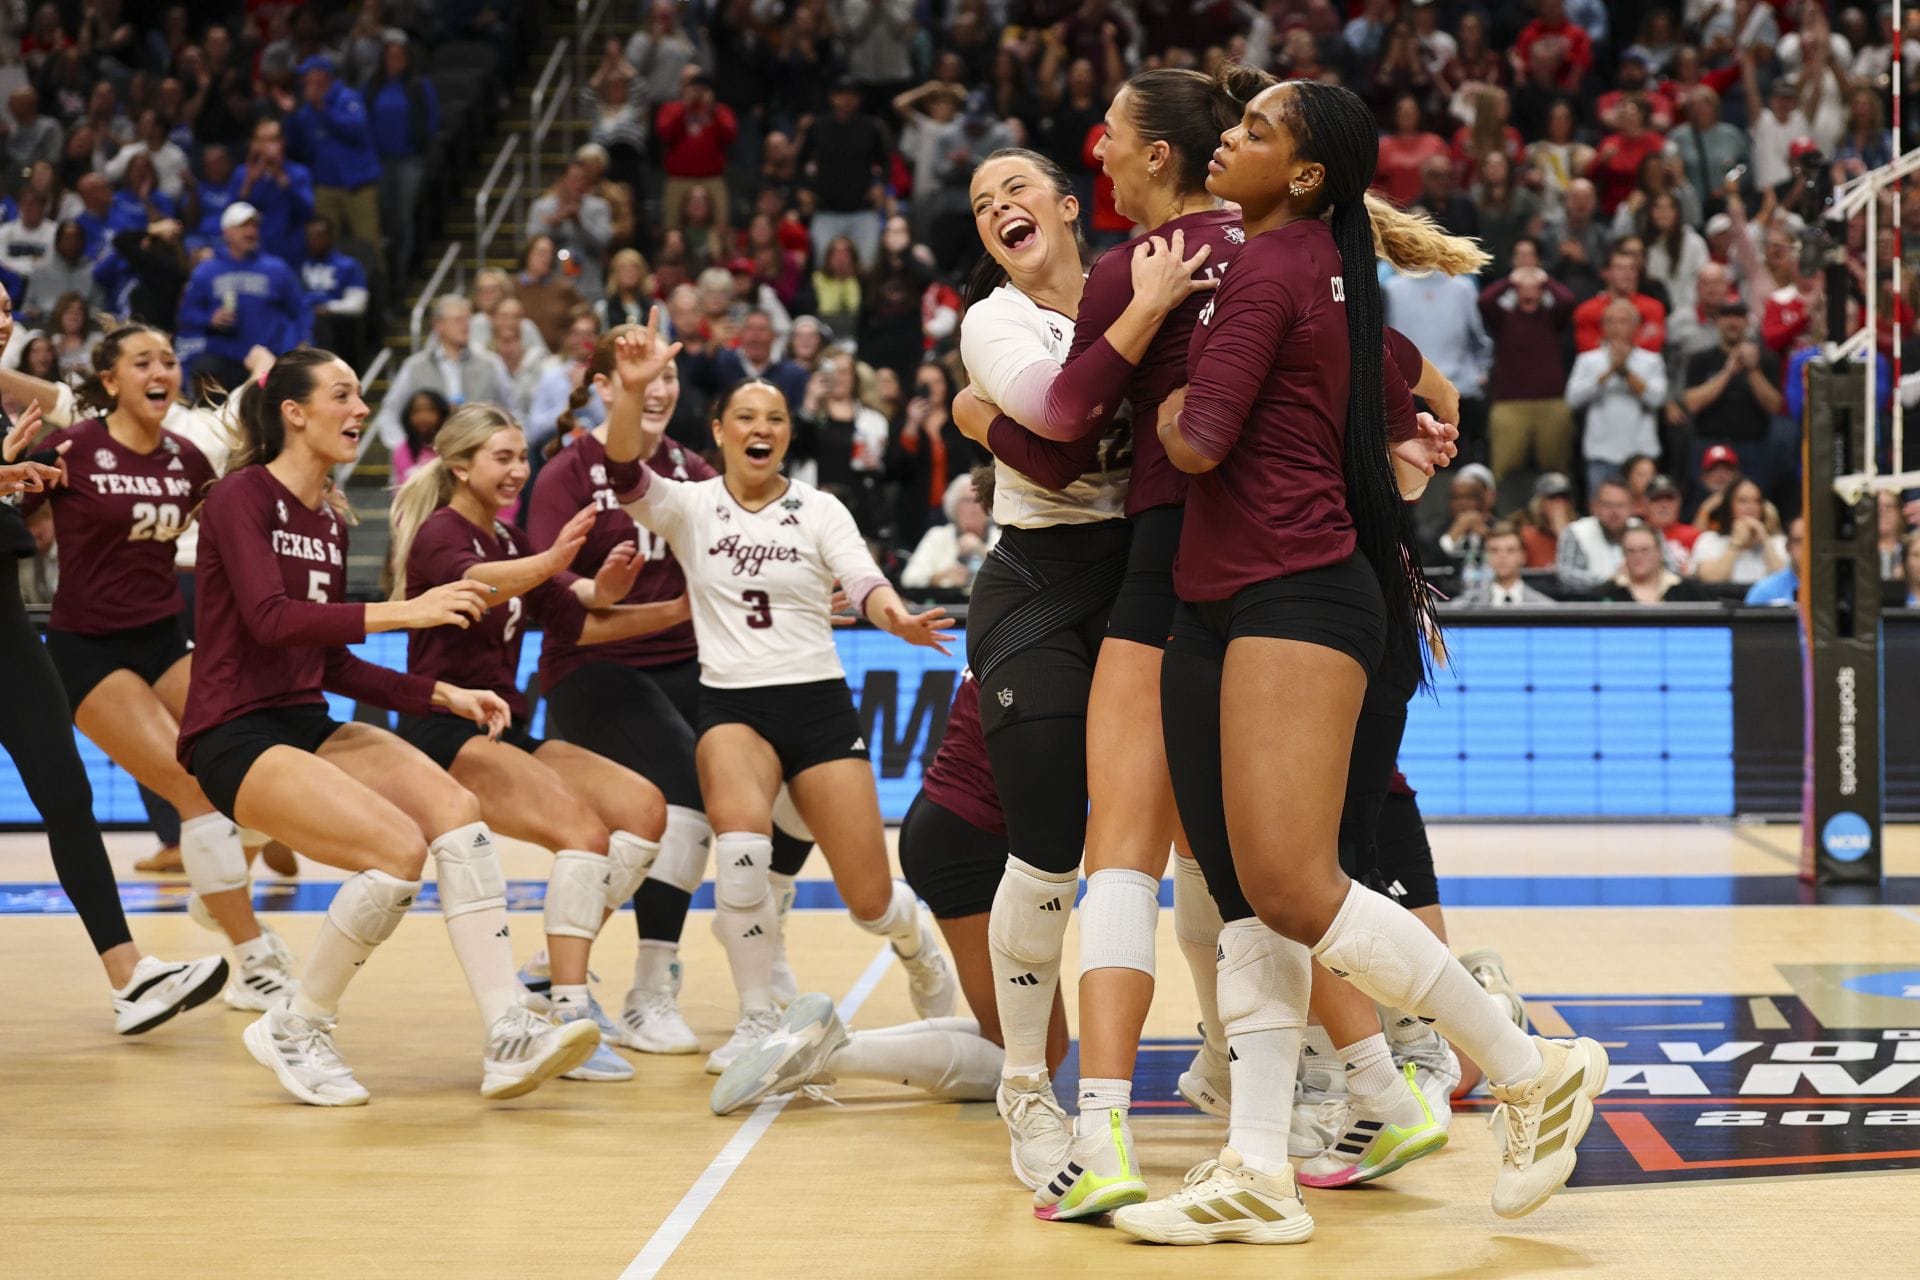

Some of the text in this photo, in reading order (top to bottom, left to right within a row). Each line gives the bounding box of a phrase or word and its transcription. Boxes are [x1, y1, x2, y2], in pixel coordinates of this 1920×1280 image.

[89, 473, 162, 496] TEXAS
[127, 502, 181, 542] 20
[272, 529, 326, 562] TEXAS
[708, 534, 802, 577] Aggies
[307, 569, 331, 604] 5
[504, 597, 522, 643] 2
[742, 589, 773, 629] 3
